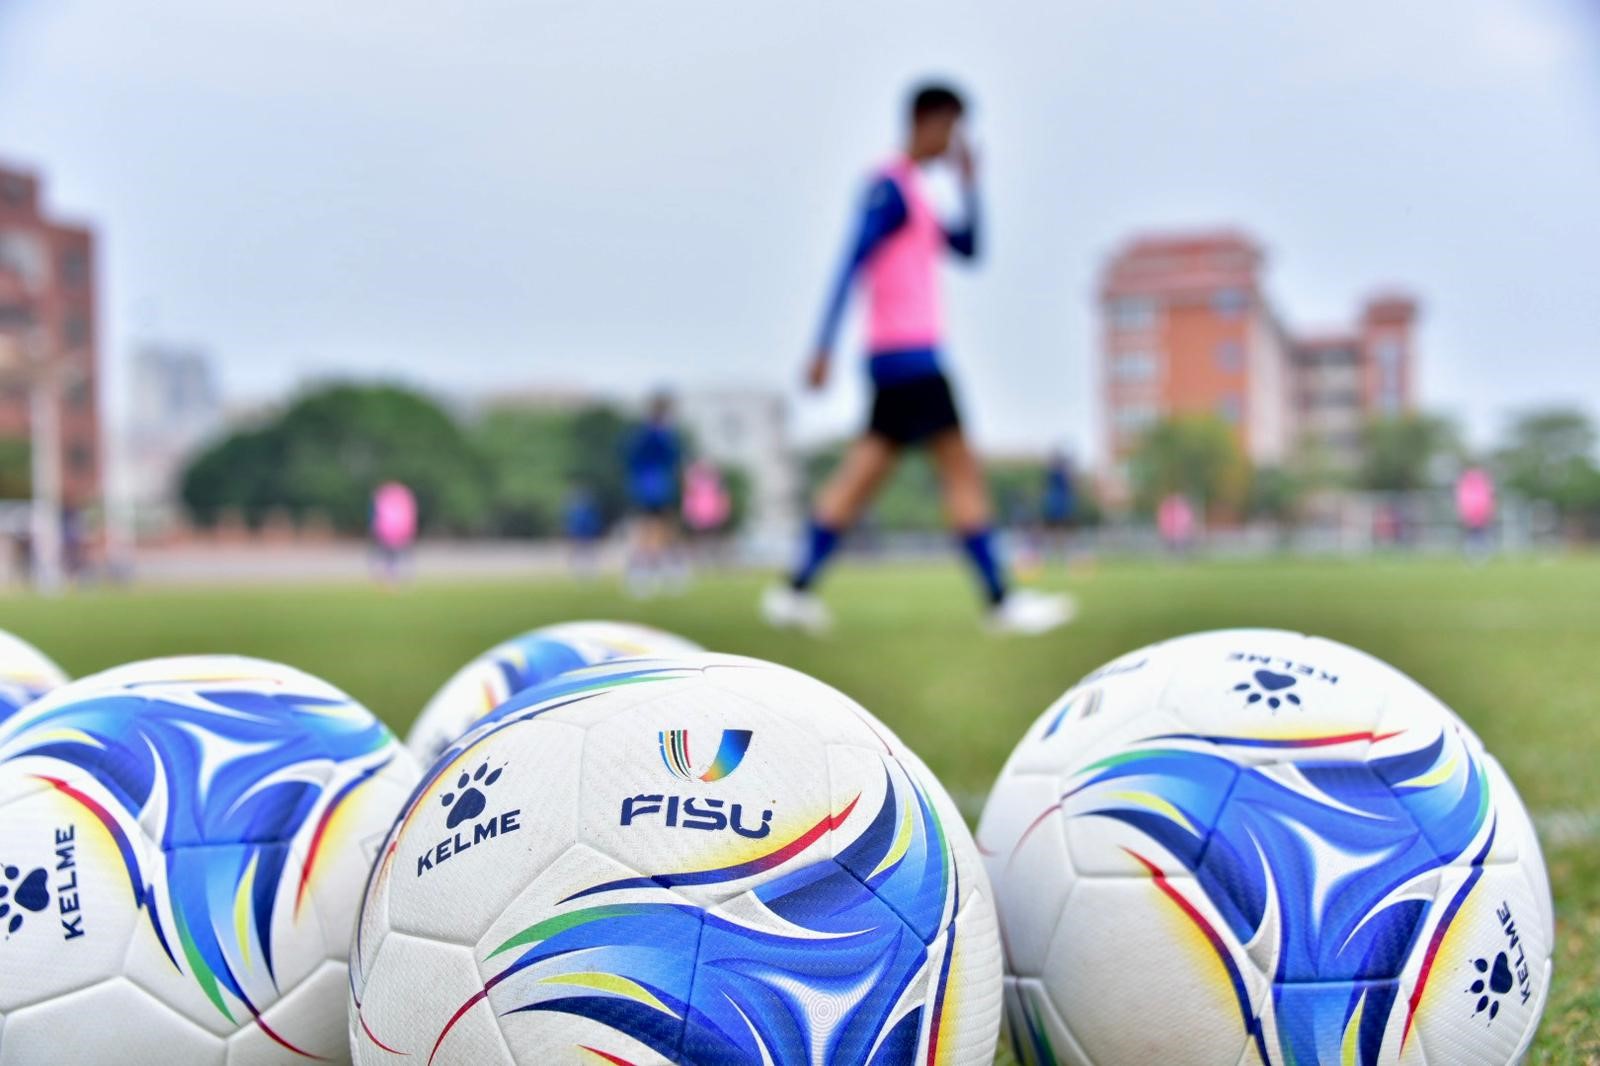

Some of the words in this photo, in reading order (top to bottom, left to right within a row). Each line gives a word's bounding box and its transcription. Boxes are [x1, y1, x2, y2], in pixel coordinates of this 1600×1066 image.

[1226, 651, 1339, 686] KELME
[417, 809, 521, 878] KELME
[620, 794, 774, 840] FISU
[55, 825, 84, 941] KELME
[1496, 901, 1531, 1006] KELME
